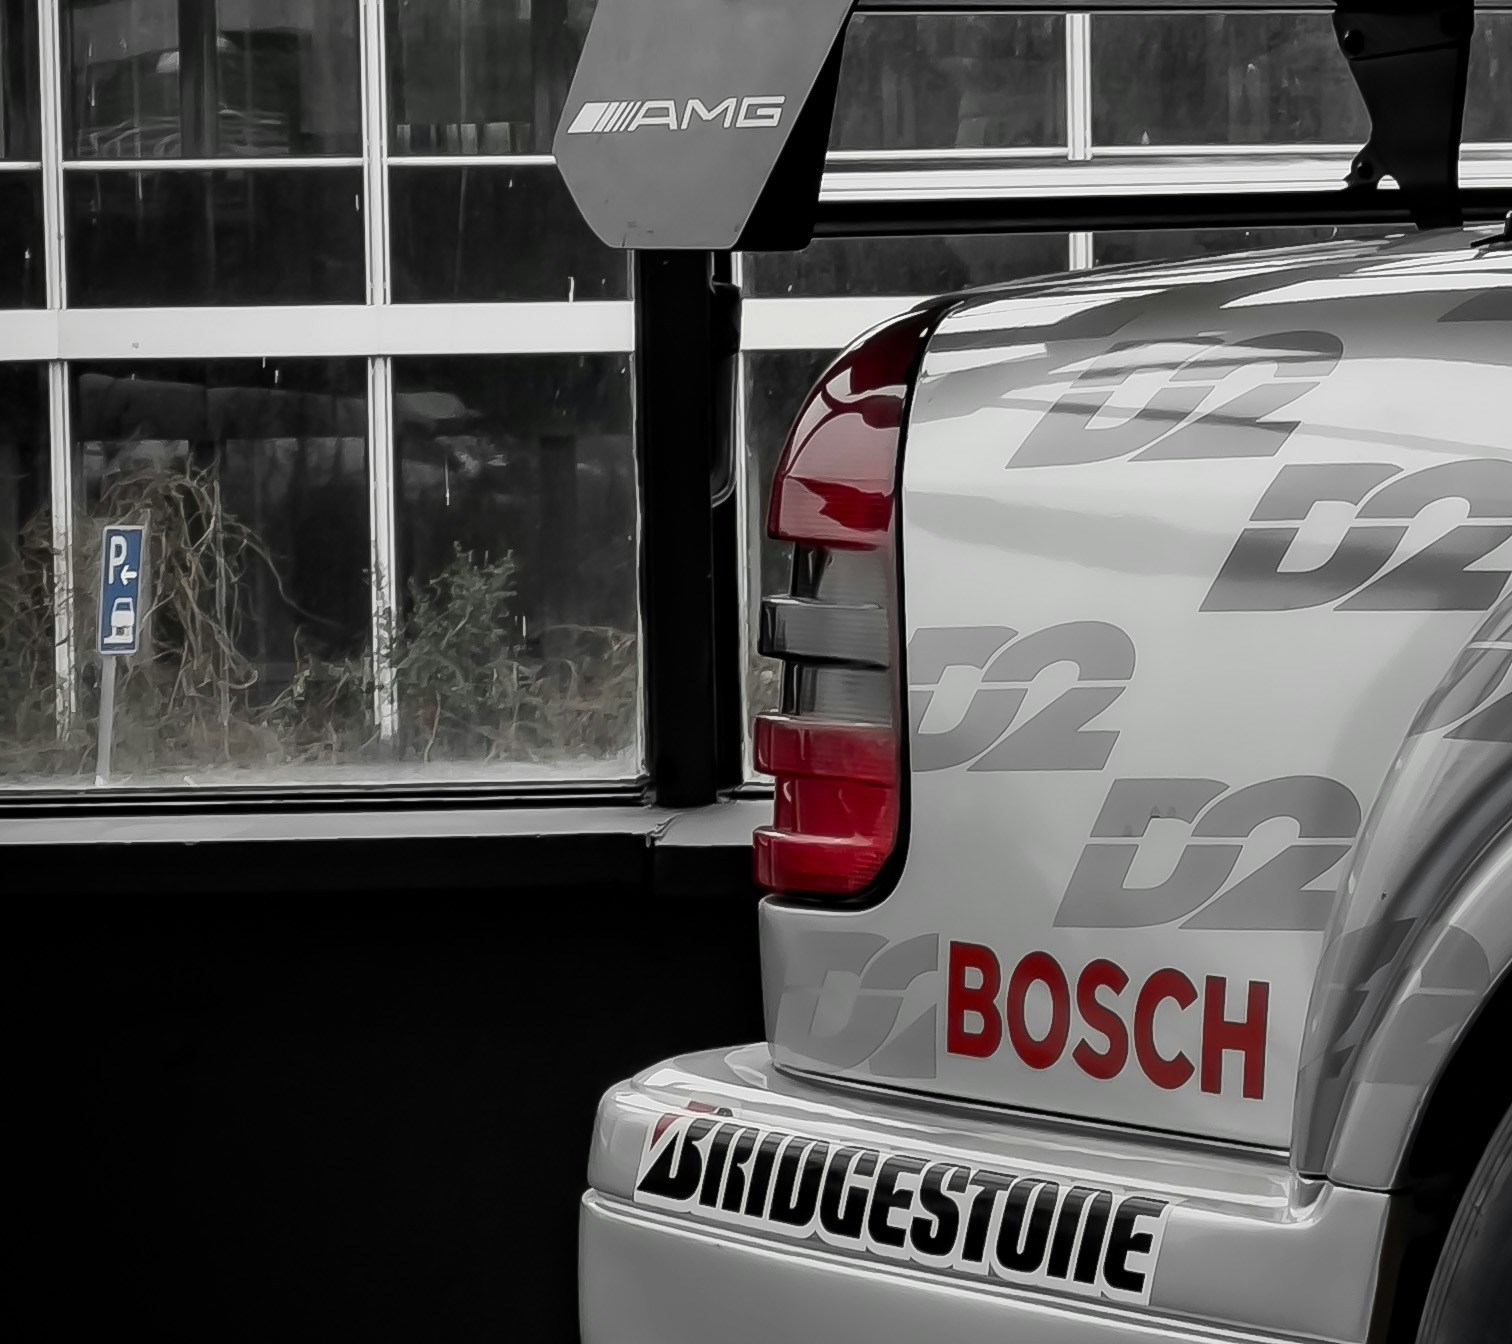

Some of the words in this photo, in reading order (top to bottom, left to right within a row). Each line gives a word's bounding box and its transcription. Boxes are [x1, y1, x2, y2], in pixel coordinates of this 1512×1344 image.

[629, 95, 785, 132] AMG
[108, 535, 128, 585] P
[910, 620, 1136, 772] D2
[1053, 775, 1361, 931] D2
[947, 941, 1270, 1101] BOSCH
[636, 1118, 1171, 1293] BRIDGESTONE
